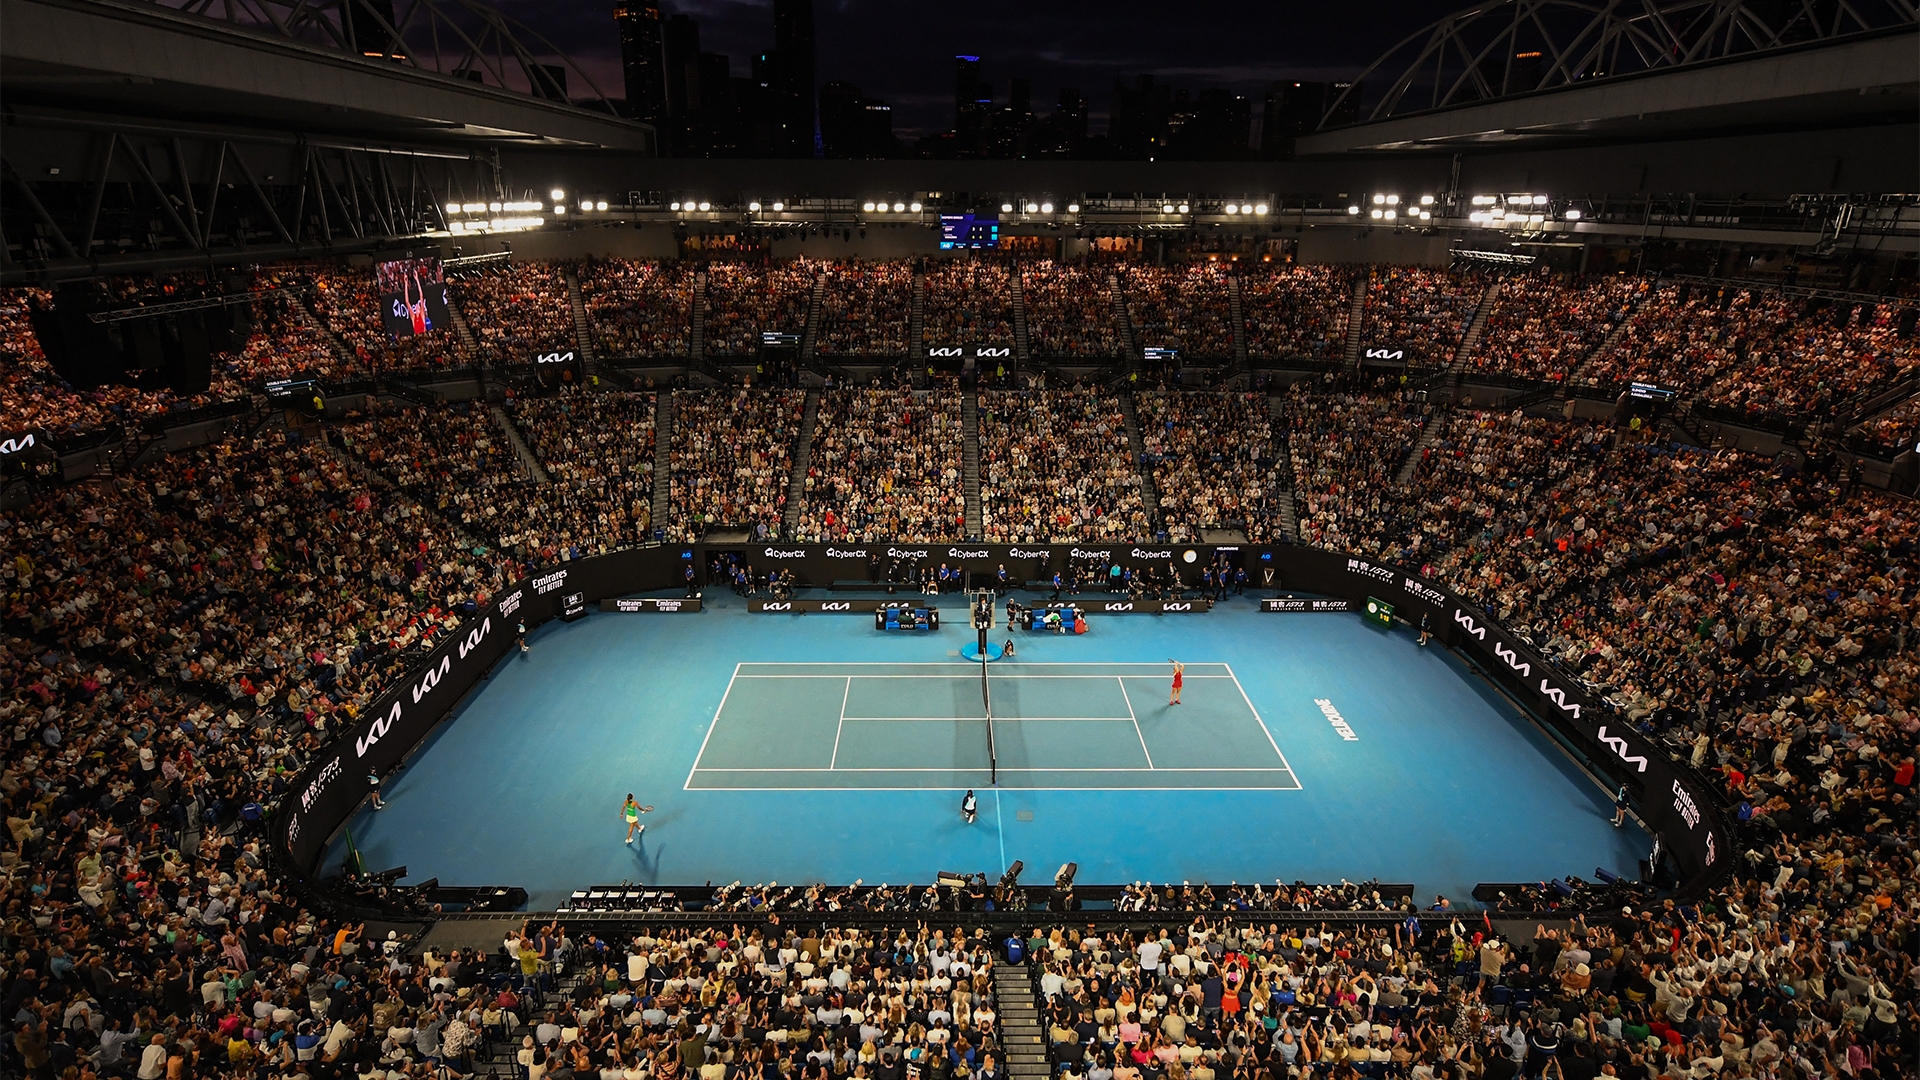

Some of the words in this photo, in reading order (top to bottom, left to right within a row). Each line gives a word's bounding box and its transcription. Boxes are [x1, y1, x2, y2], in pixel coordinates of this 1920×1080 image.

[537, 351, 574, 364] KIA
[929, 347, 963, 357] KIA
[976, 347, 1010, 357] KIA
[1366, 348, 1403, 360] KIA
[773, 550, 806, 559] CyberCX
[834, 550, 867, 559] CyberCX
[957, 550, 989, 559] CyberCX
[1079, 550, 1111, 559] CyberCX
[1140, 550, 1172, 559] CyberCX
[532, 569, 568, 589] Emirates
[499, 589, 522, 613] Emirates
[762, 602, 791, 610] KIA
[821, 602, 850, 611] KIA
[1105, 602, 1133, 611] KIA
[1163, 602, 1191, 611] KIA
[1454, 608, 1486, 641] KIA
[459, 616, 491, 659] KIA
[1495, 642, 1531, 677] KIA
[412, 654, 451, 704] KIA
[1540, 678, 1581, 719] KIA
[1313, 698, 1360, 741] MELBOURNE
[355, 700, 402, 758] KIA
[1598, 726, 1648, 773] KIA
[1672, 778, 1701, 824] Emirates
